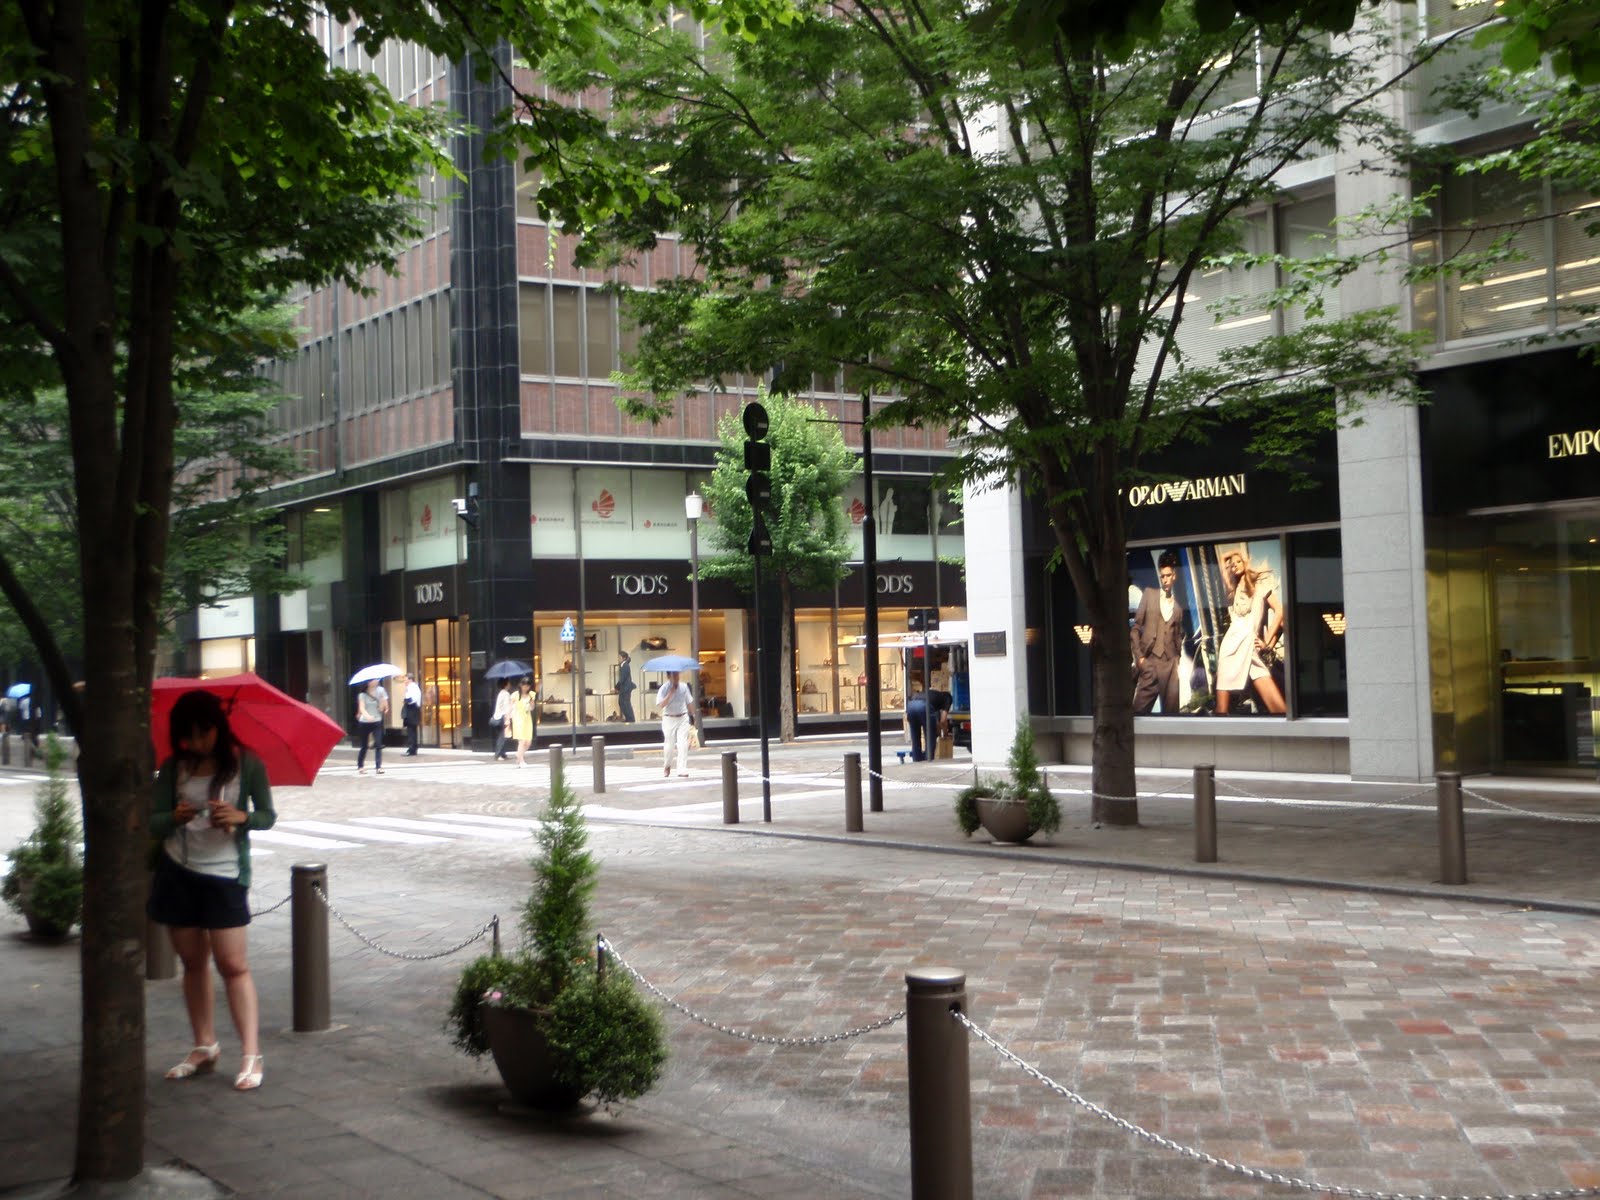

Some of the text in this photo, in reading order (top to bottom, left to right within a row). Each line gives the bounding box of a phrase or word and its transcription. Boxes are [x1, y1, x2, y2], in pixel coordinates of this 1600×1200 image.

[1118, 473, 1245, 507] ORIO ARMANI
[610, 574, 668, 595] TOD'S
[876, 574, 913, 594] OD'S
